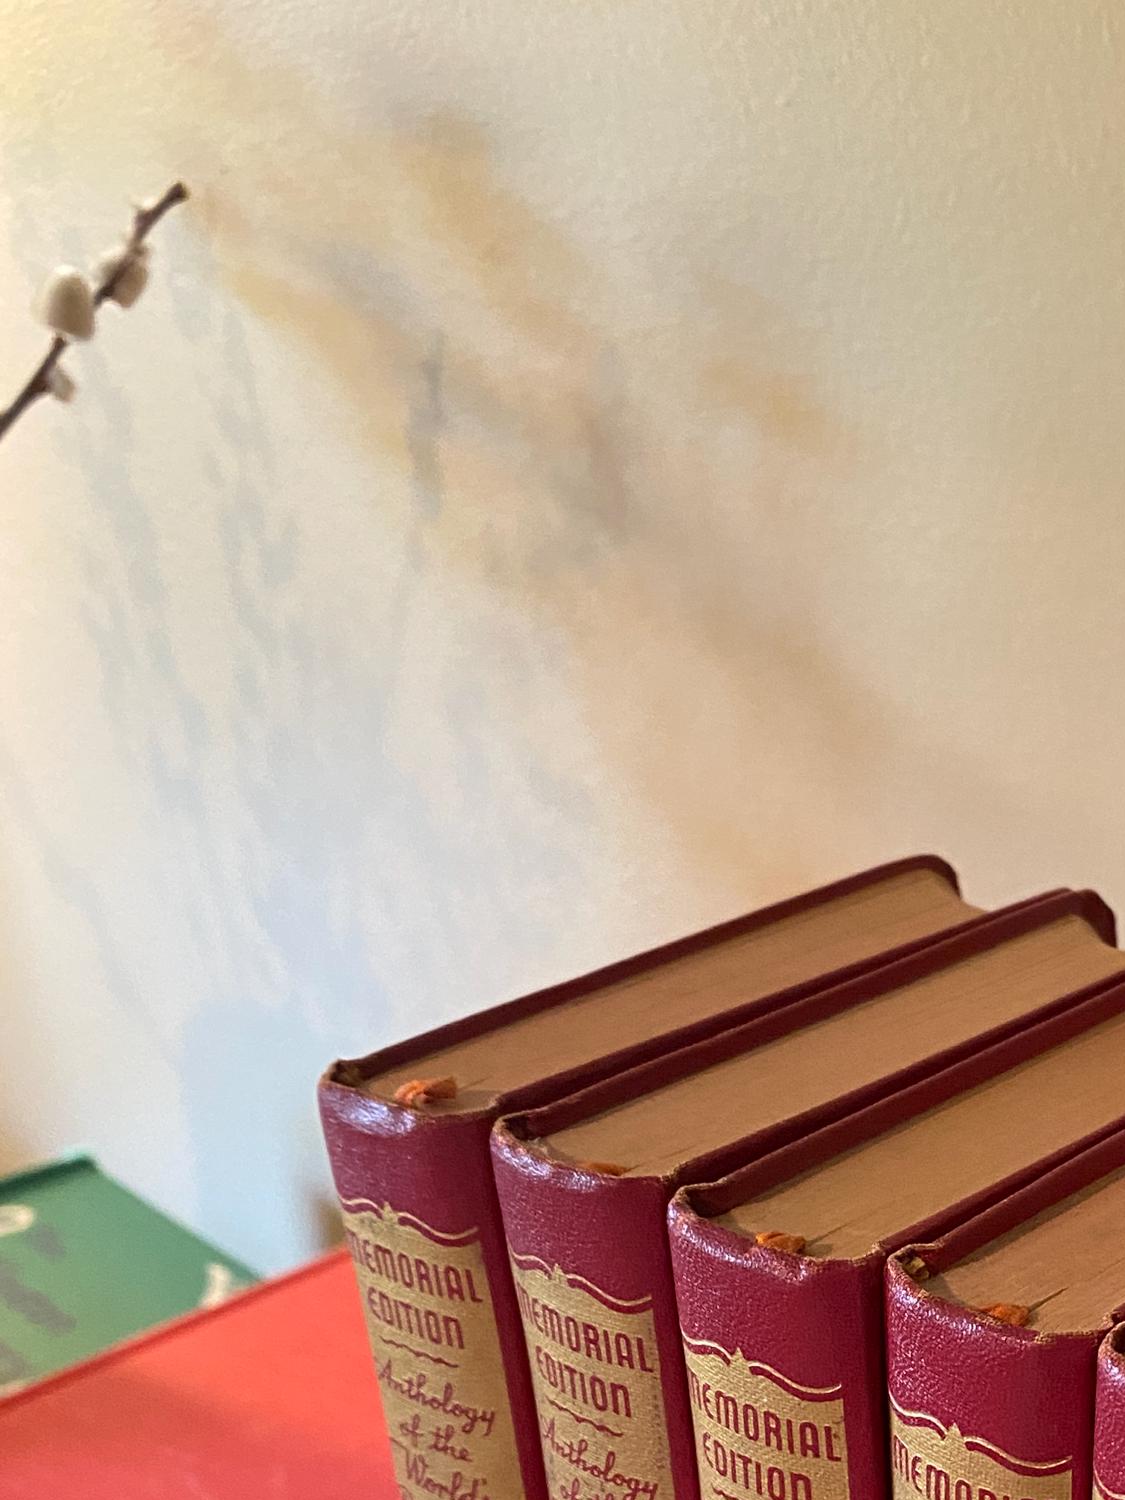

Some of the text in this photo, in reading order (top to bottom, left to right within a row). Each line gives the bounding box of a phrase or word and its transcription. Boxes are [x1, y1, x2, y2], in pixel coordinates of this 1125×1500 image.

[346, 1229, 483, 1303] MEMORIAL
[366, 1286, 465, 1350] EDITION
[516, 1281, 654, 1374] MEMORIAL
[377, 1358, 496, 1437] Anthology
[535, 1345, 632, 1419] EDITION
[688, 1366, 843, 1463] MEMORIAL
[399, 1413, 473, 1463] of the
